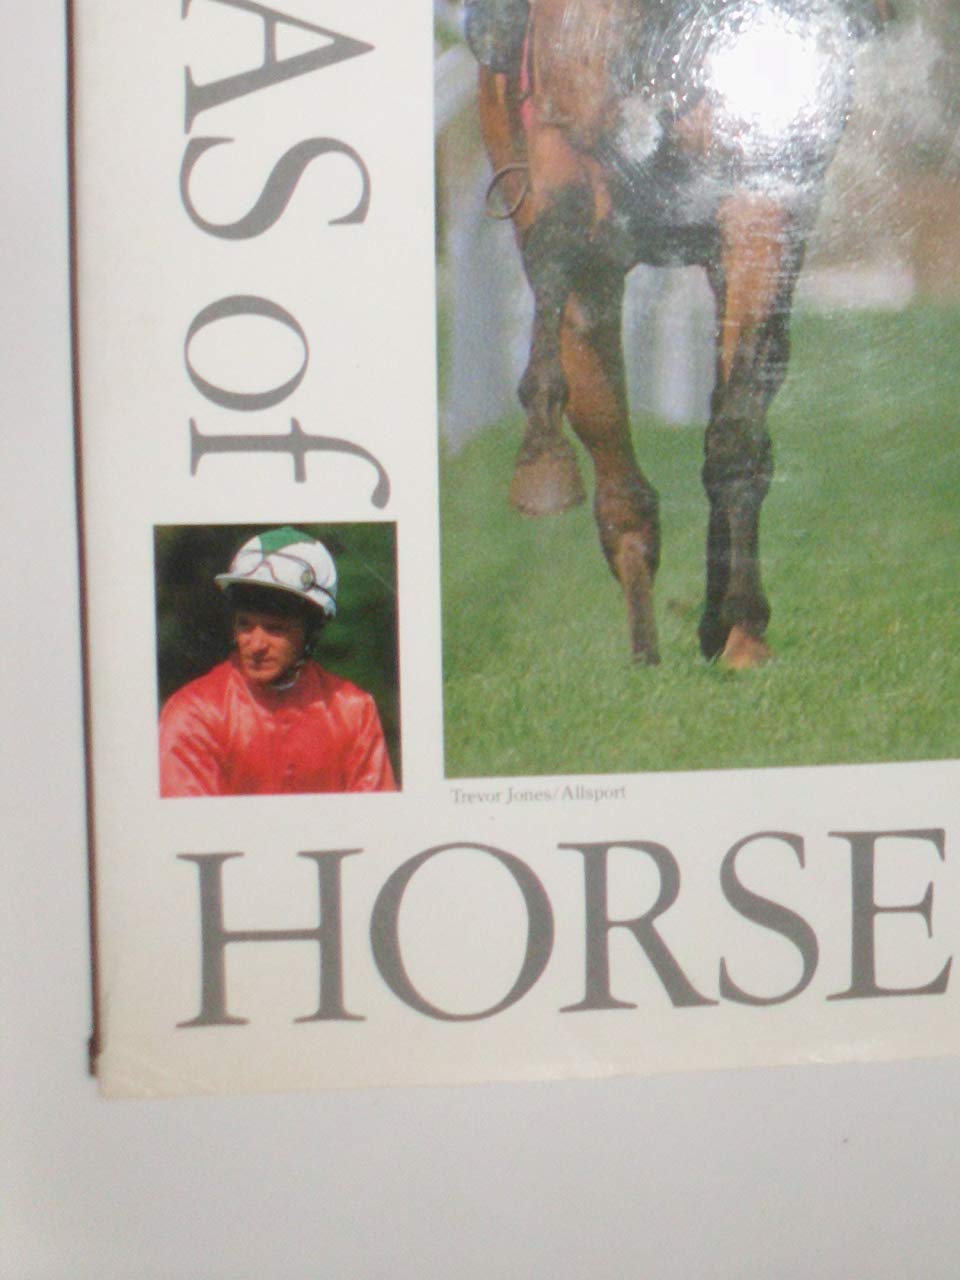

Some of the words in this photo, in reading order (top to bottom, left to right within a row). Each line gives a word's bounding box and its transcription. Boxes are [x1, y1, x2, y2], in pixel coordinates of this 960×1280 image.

[184, 294, 391, 510] of
[450, 787, 502, 806] Trevor
[176, 827, 954, 1029] HORSE
